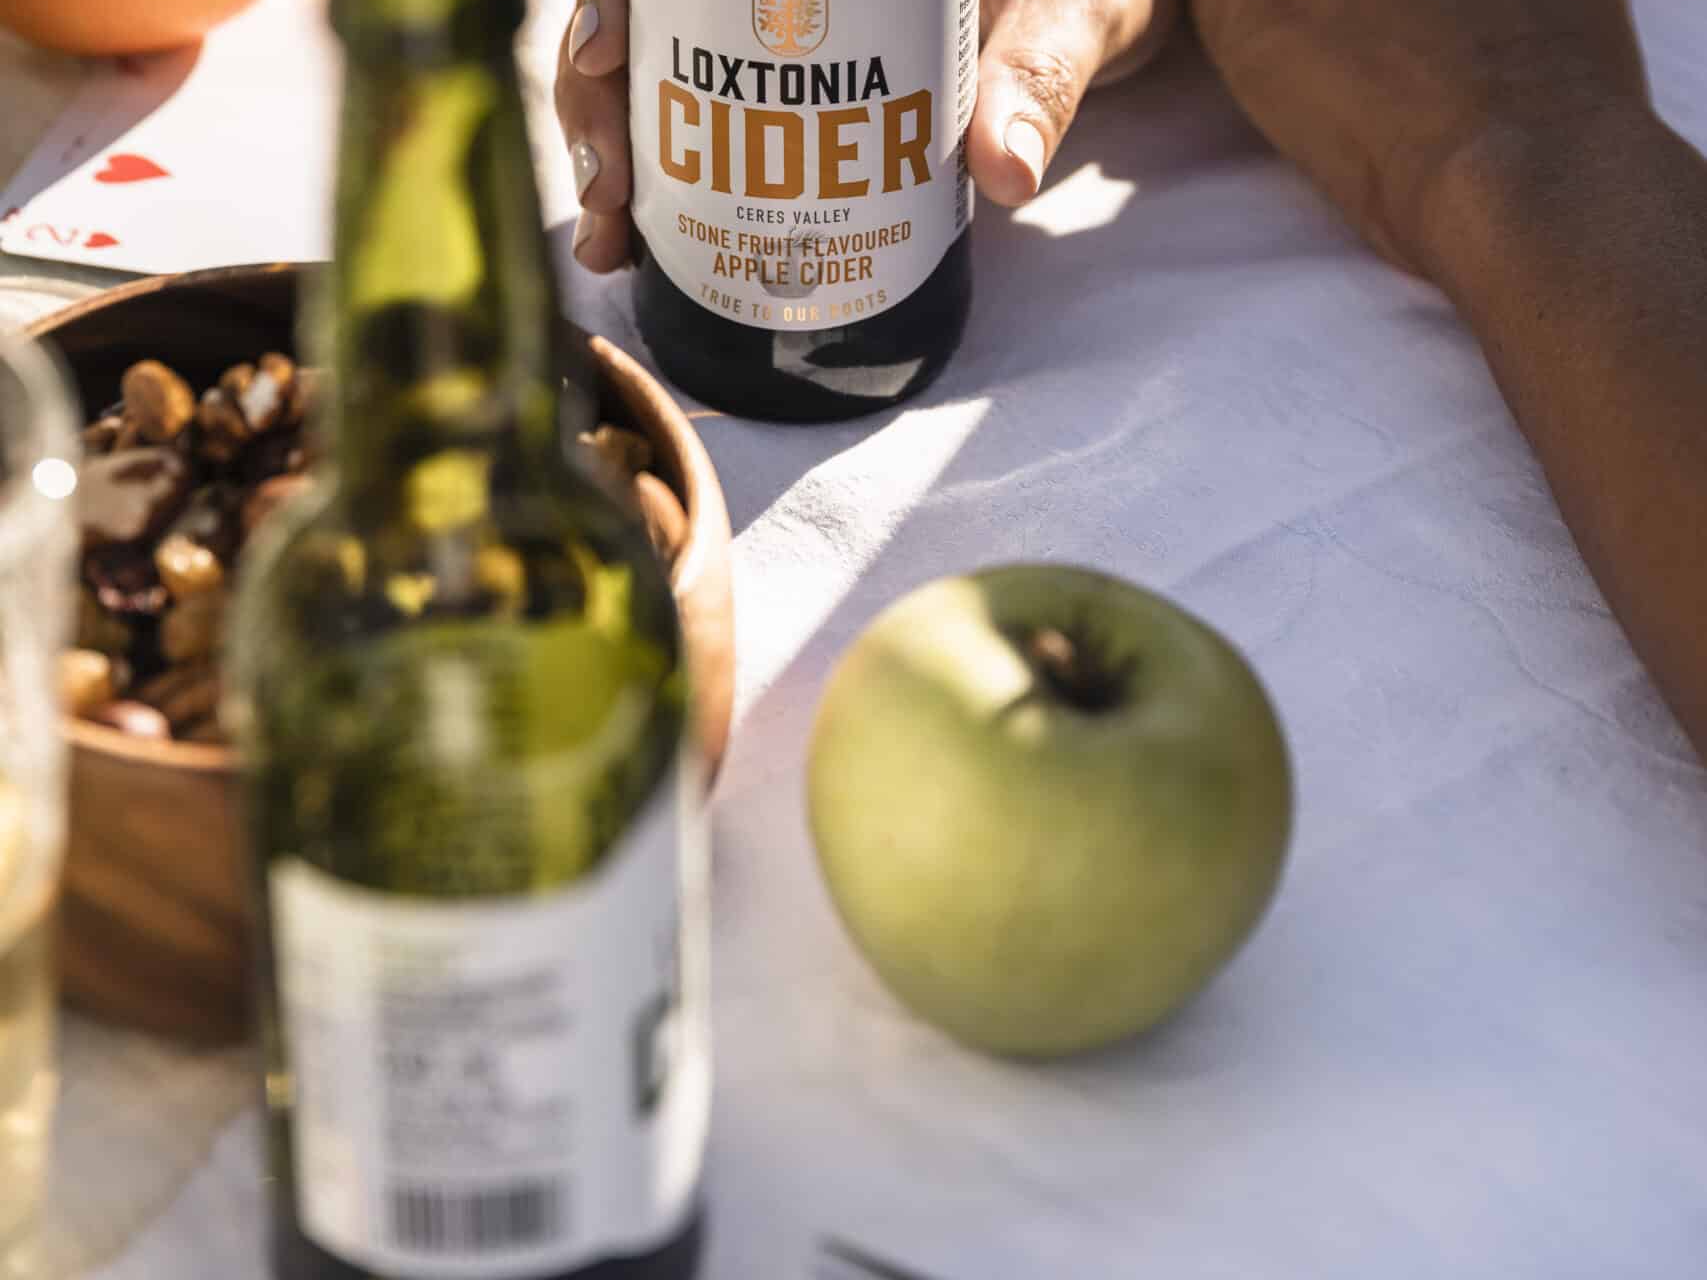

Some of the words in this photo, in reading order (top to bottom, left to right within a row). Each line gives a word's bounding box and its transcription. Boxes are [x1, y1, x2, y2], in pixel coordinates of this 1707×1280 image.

[672, 37, 890, 106] LOXTONIA
[659, 79, 932, 200] CIDER
[678, 214, 731, 249] STONE
[738, 232, 794, 257] FRUIT
[802, 220, 912, 257] FLAVOURED
[736, 206, 785, 224] CERES
[793, 207, 850, 224] VALLEY
[714, 252, 790, 285] APPLE
[800, 256, 873, 286] CIDER
[700, 284, 742, 314] TRUE
[752, 304, 772, 321] TO
[783, 306, 818, 323] OUR
